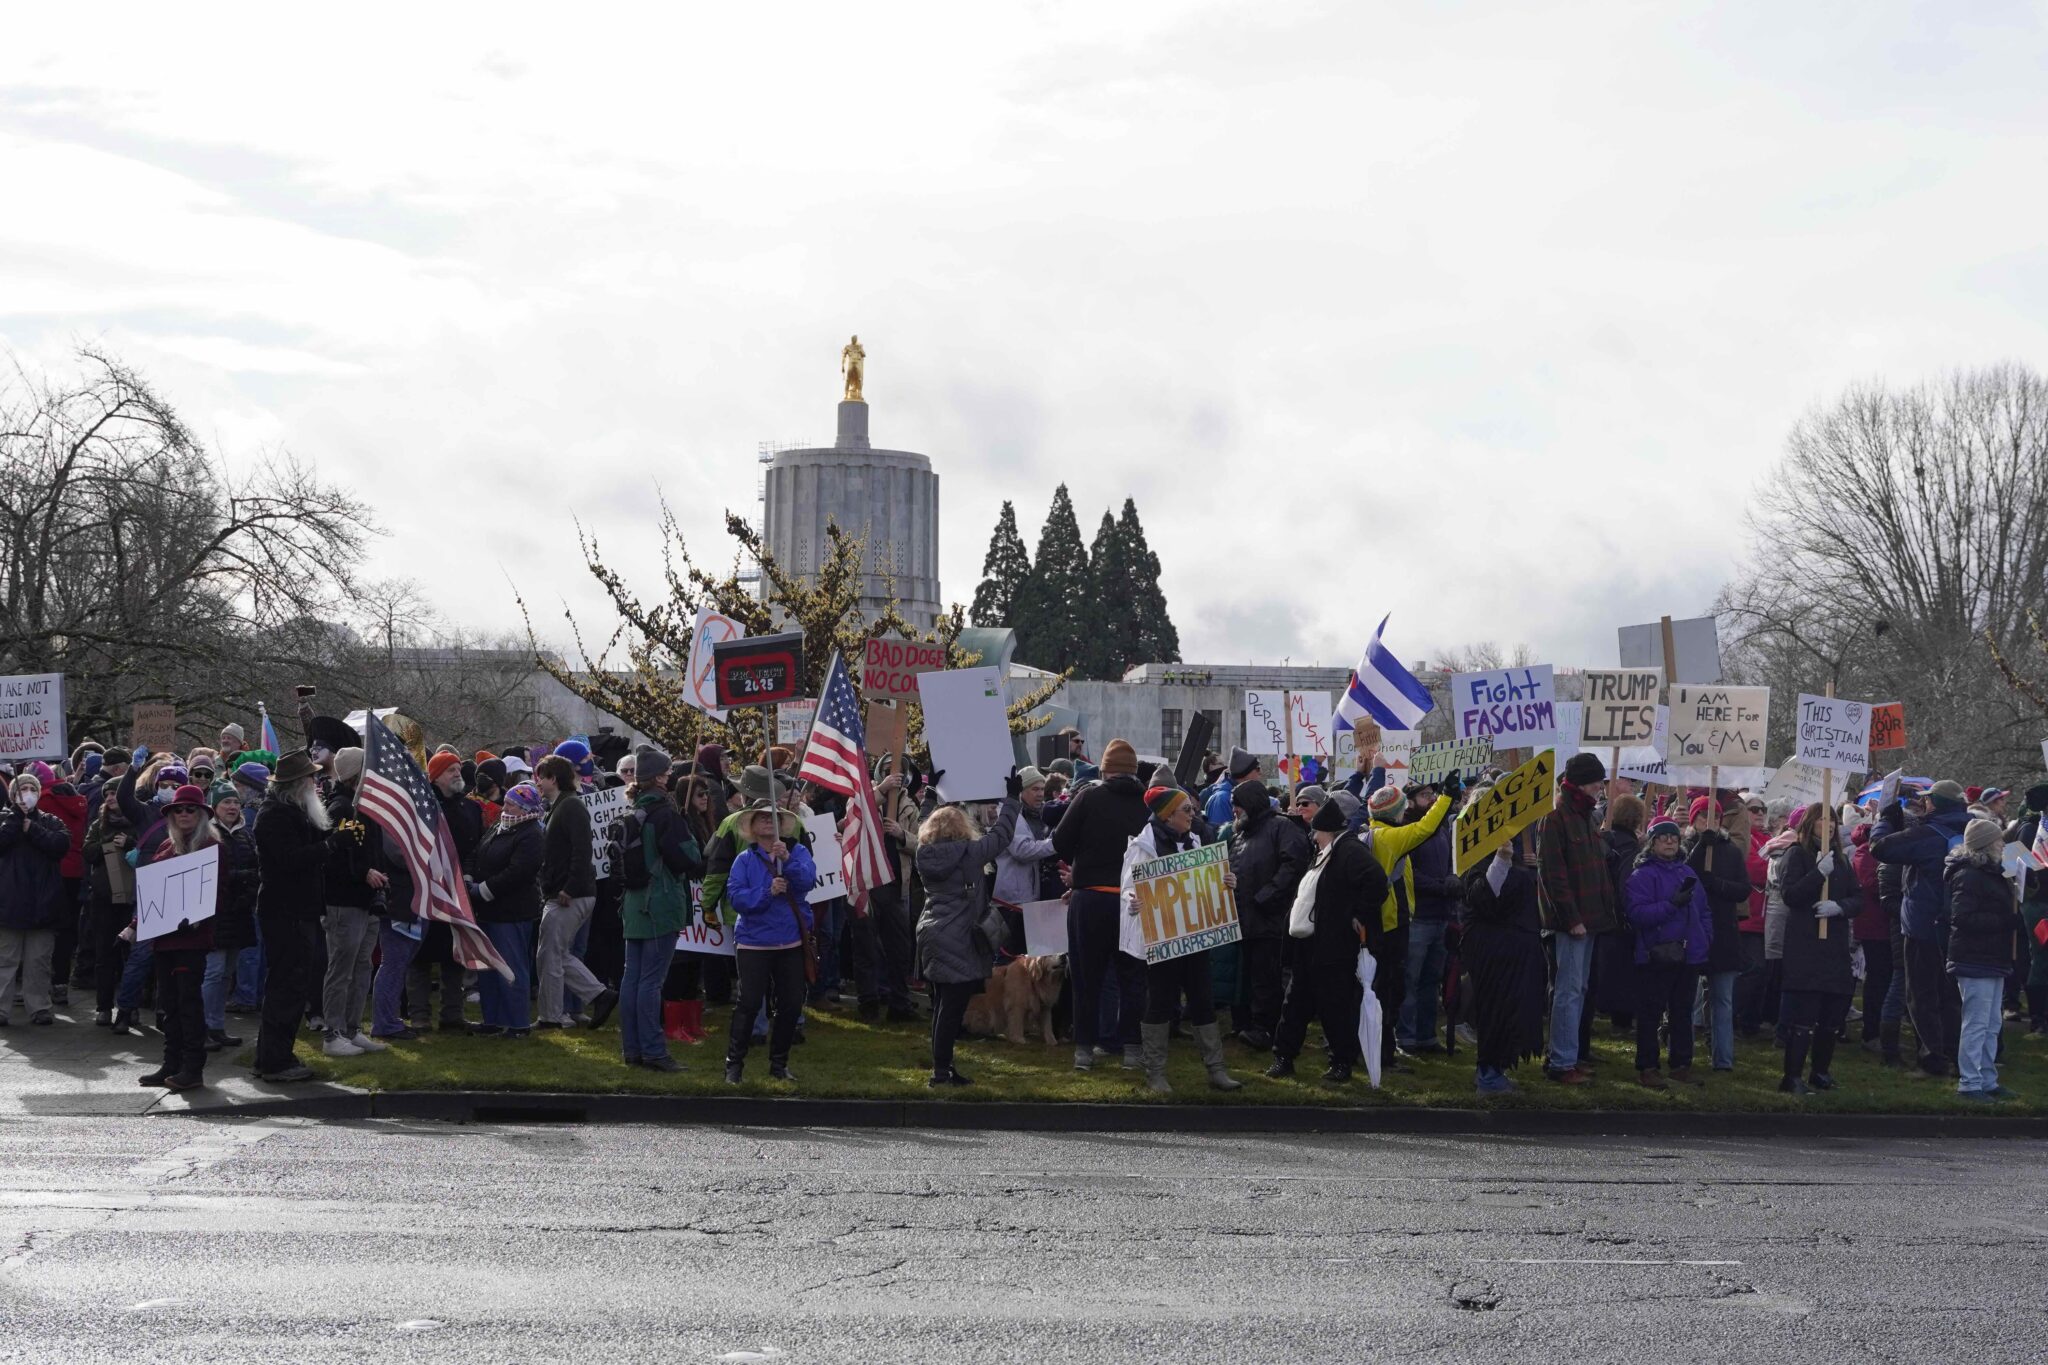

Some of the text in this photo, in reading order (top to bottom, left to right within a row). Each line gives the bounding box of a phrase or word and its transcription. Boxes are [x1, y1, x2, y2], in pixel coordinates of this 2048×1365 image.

[867, 639, 945, 668] BAD DOGE
[6, 682, 23, 698] ARE
[27, 680, 52, 696] NOT
[865, 669, 888, 690] NO
[1587, 673, 1658, 701] TRUMP
[1680, 688, 1730, 705] I AM
[0, 701, 42, 720] GENOUS
[1248, 692, 1286, 755] DEPORT
[1463, 700, 1555, 737] FASCISM
[1583, 705, 1655, 741] LIES
[1696, 706, 1733, 722] HERE
[1803, 701, 1833, 723] THIS
[30, 720, 50, 737] ARE
[1290, 694, 1329, 756] MUSK
[1800, 721, 1864, 745] CHRISTIAN
[1871, 717, 1902, 732] OUR
[1718, 730, 1760, 754] Me
[1410, 742, 1494, 775] REJECT FASCISM
[1802, 745, 1865, 768] ANTI MAGA
[1460, 759, 1549, 832] MAGA
[1461, 782, 1551, 856] HELL
[137, 860, 217, 925] WTF
[1134, 861, 1239, 946] IMPEACH
